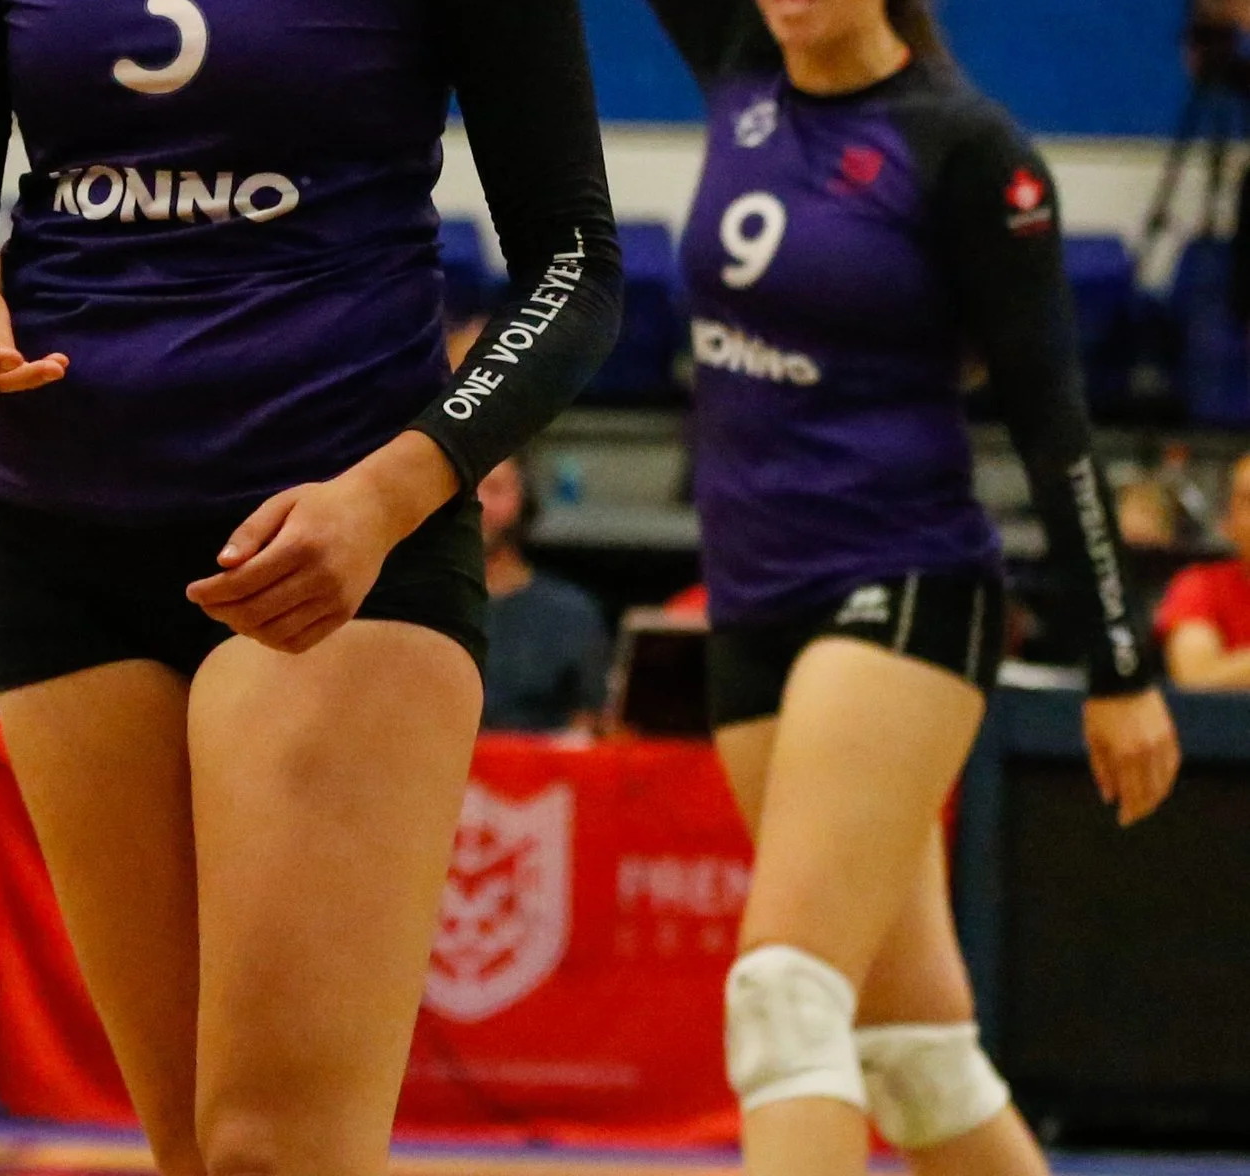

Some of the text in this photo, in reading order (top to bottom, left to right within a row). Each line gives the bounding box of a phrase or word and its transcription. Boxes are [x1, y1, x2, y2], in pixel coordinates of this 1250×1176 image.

[50, 165, 300, 223] KONNO
[719, 191, 787, 289] 9
[442, 366, 505, 421] ONE
